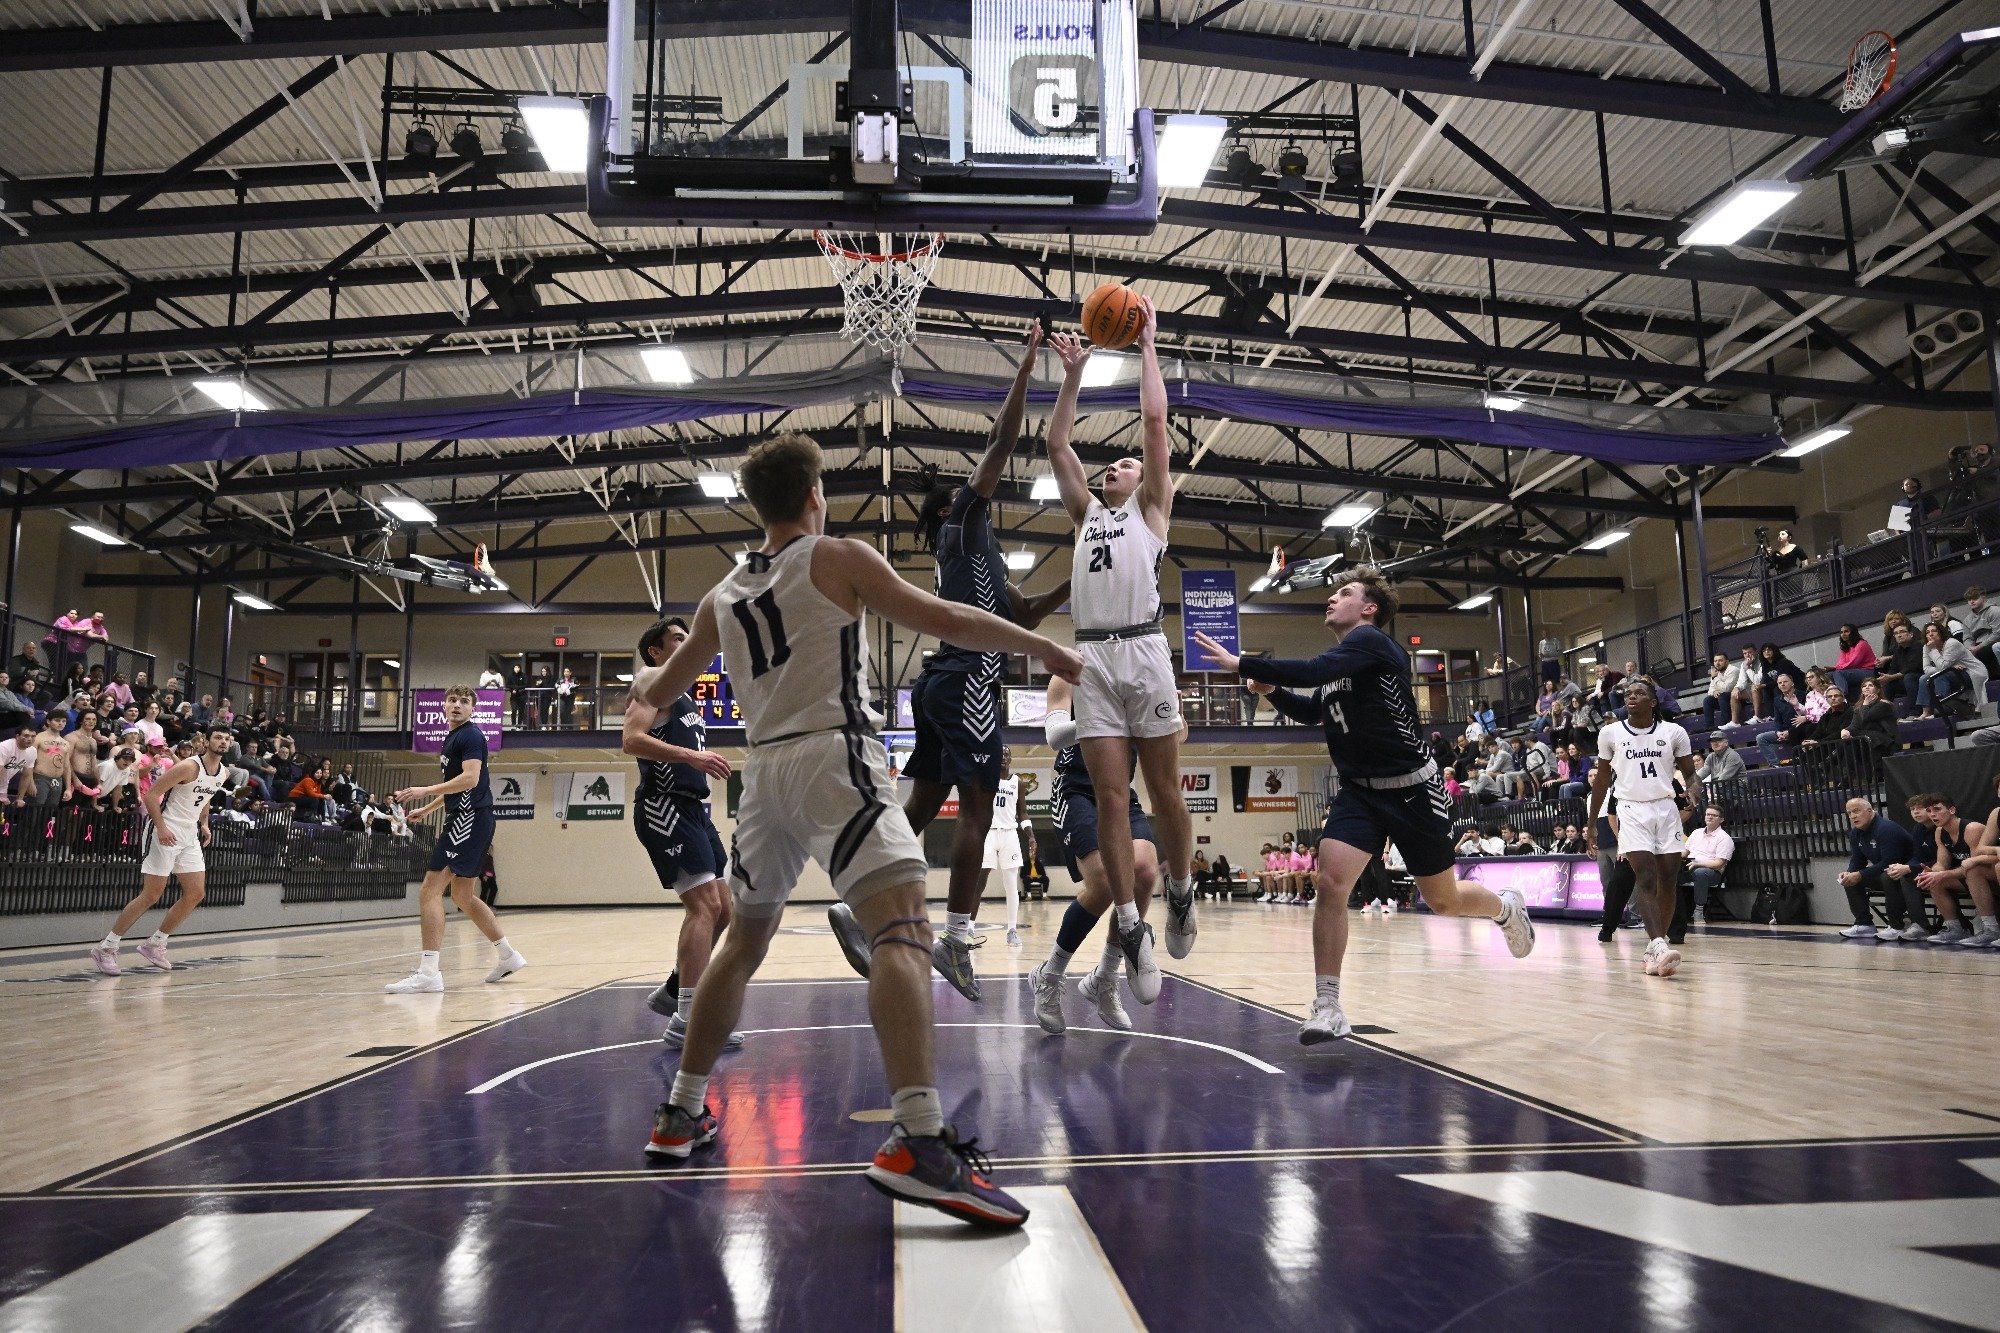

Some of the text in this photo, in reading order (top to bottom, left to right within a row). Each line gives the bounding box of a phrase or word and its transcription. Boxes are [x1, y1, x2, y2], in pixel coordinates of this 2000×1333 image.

[1088, 544, 1113, 573] 24
[1184, 590, 1235, 599] INDIVIDUAL
[1184, 598, 1235, 609] QUALIFIERS
[731, 587, 791, 680] 11
[555, 637, 566, 646] EXIT
[696, 683, 717, 699] 27
[416, 711, 450, 725] UPM
[713, 707, 722, 718] 4
[1329, 701, 1349, 734] 4
[1640, 761, 1658, 778] 14
[193, 796, 204, 806] 2
[995, 796, 1006, 807] 10
[1251, 801, 1296, 809] WAYNESBURG
[1026, 803, 1050, 811] NCENT
